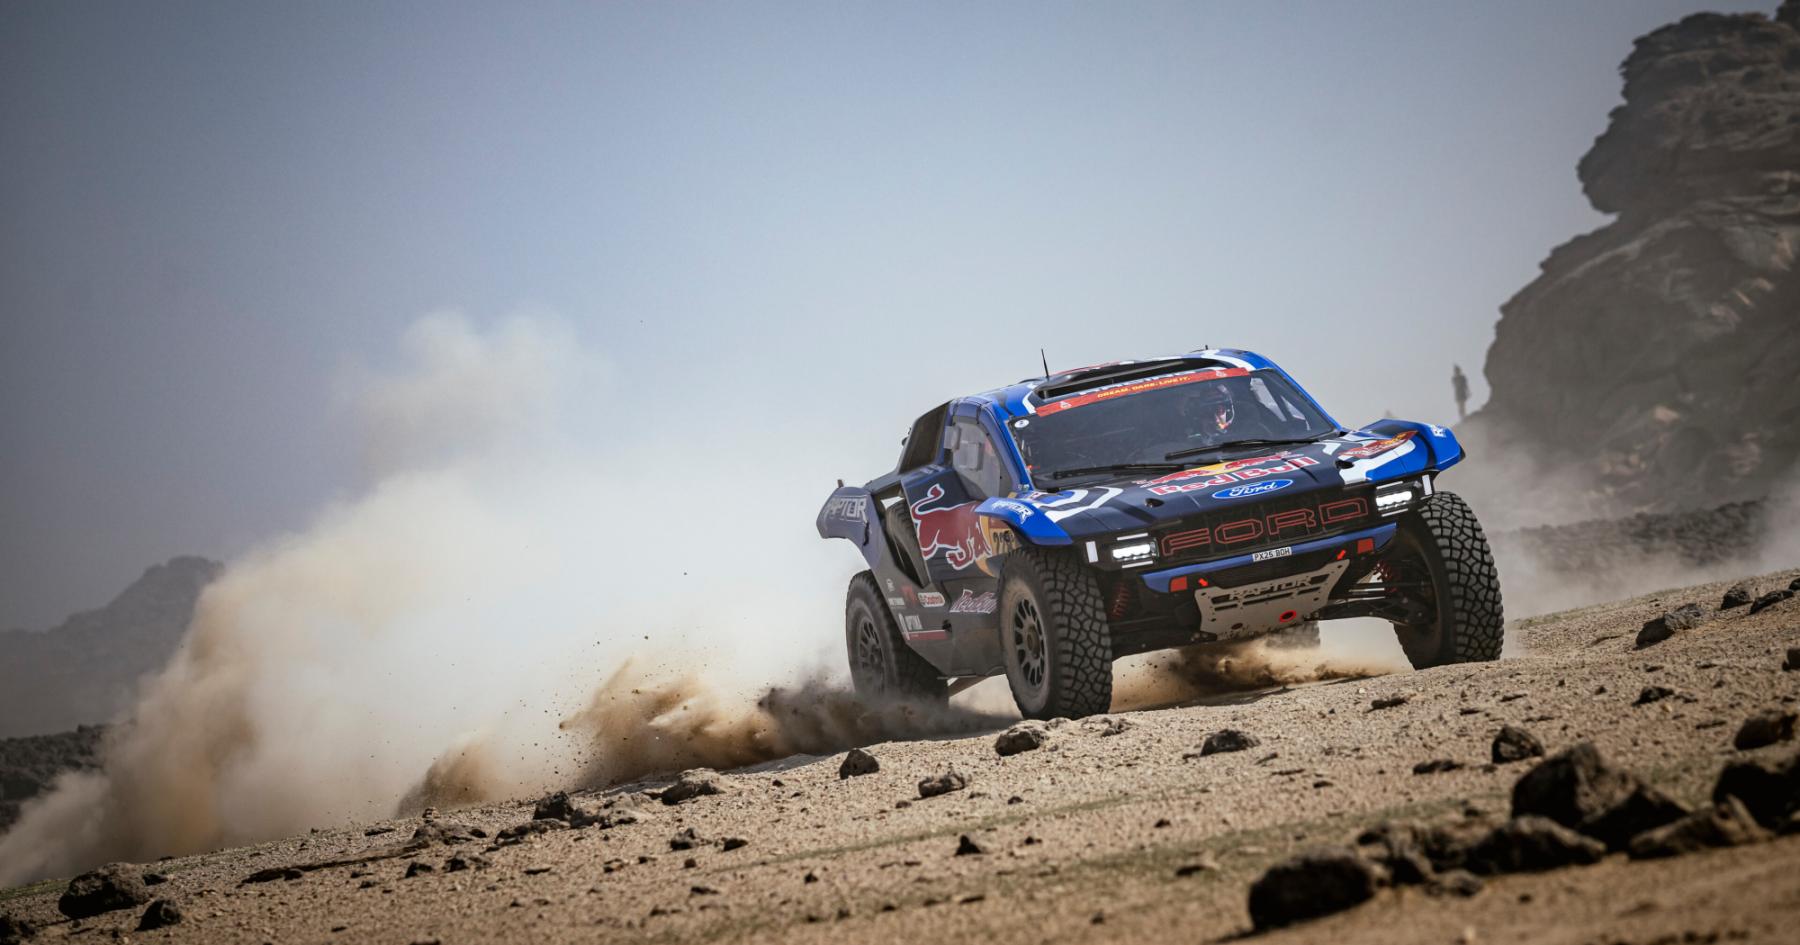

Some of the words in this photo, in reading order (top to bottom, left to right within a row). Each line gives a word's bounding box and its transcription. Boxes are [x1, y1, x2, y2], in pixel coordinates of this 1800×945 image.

[1148, 473, 1239, 496] Red
[1232, 456, 1321, 481] Bull
[1229, 480, 1278, 497] Ford
[1161, 498, 1369, 556] FORD
[1254, 550, 1273, 561] PX25
